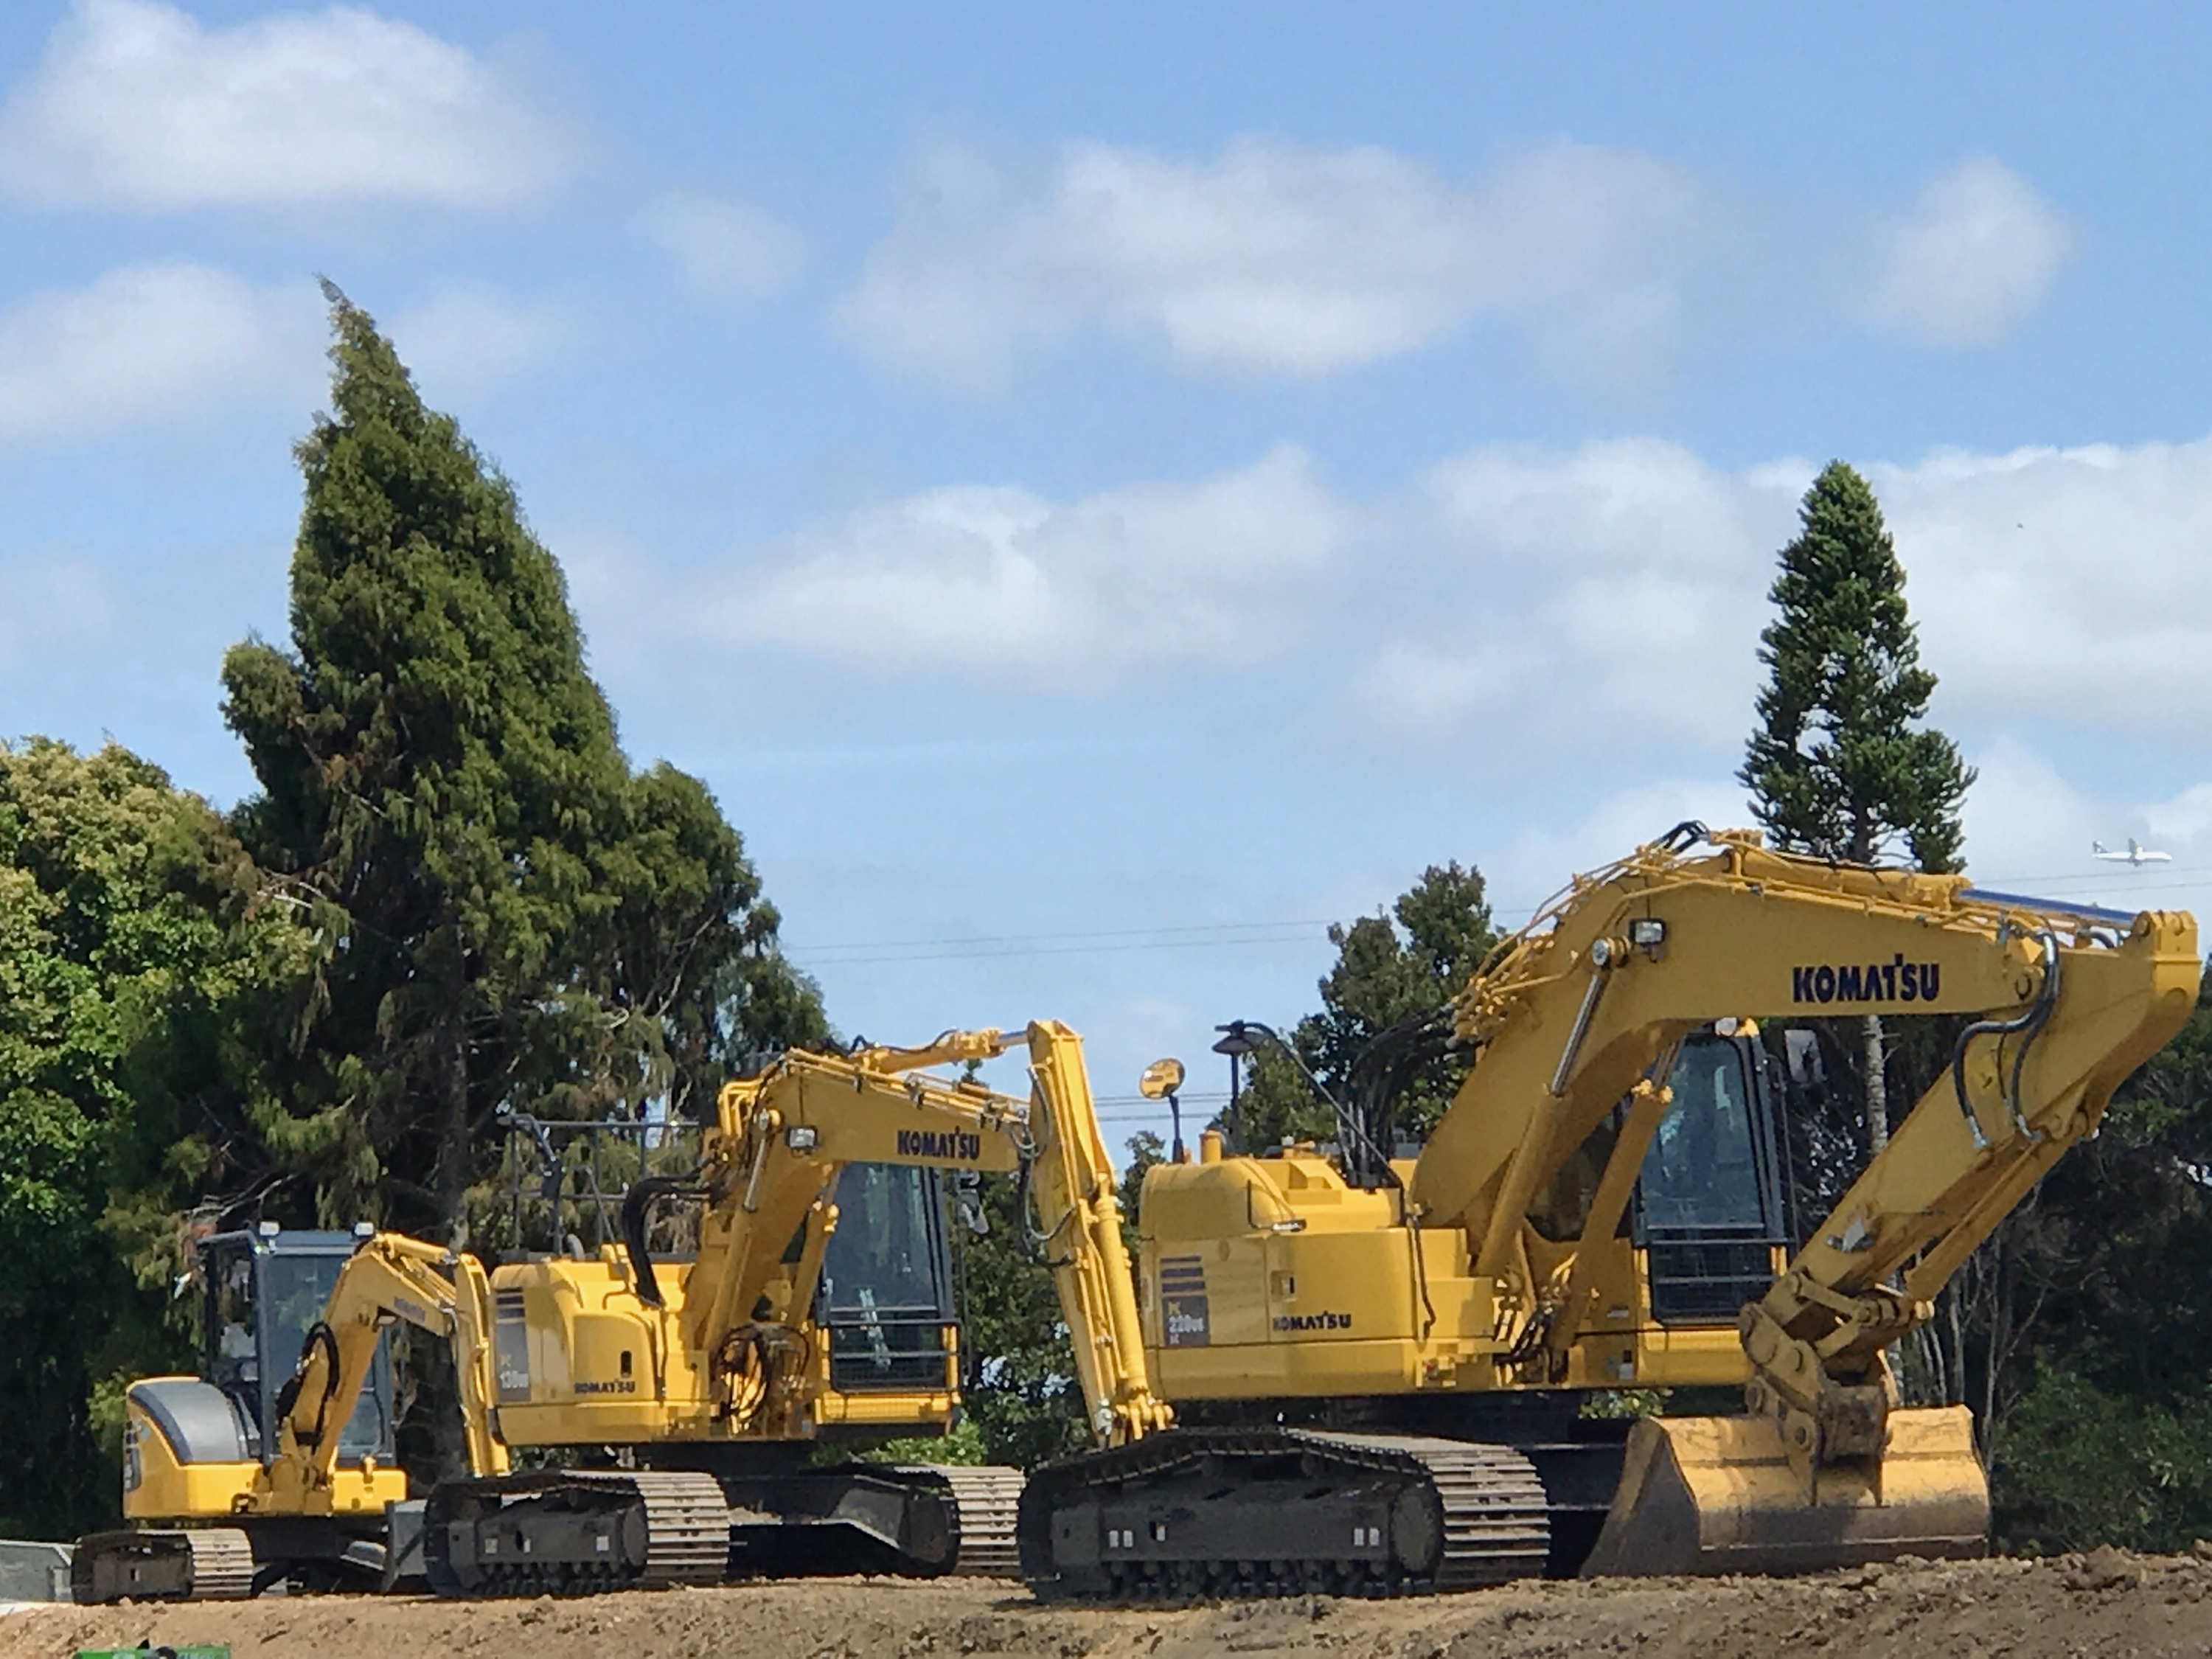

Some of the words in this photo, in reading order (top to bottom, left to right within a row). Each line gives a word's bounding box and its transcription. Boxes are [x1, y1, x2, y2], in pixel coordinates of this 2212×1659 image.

[1792, 953, 1939, 1003] KOMATSU
[897, 1125, 979, 1160] KOMATSU
[1273, 1310, 1352, 1331] KOMATSU
